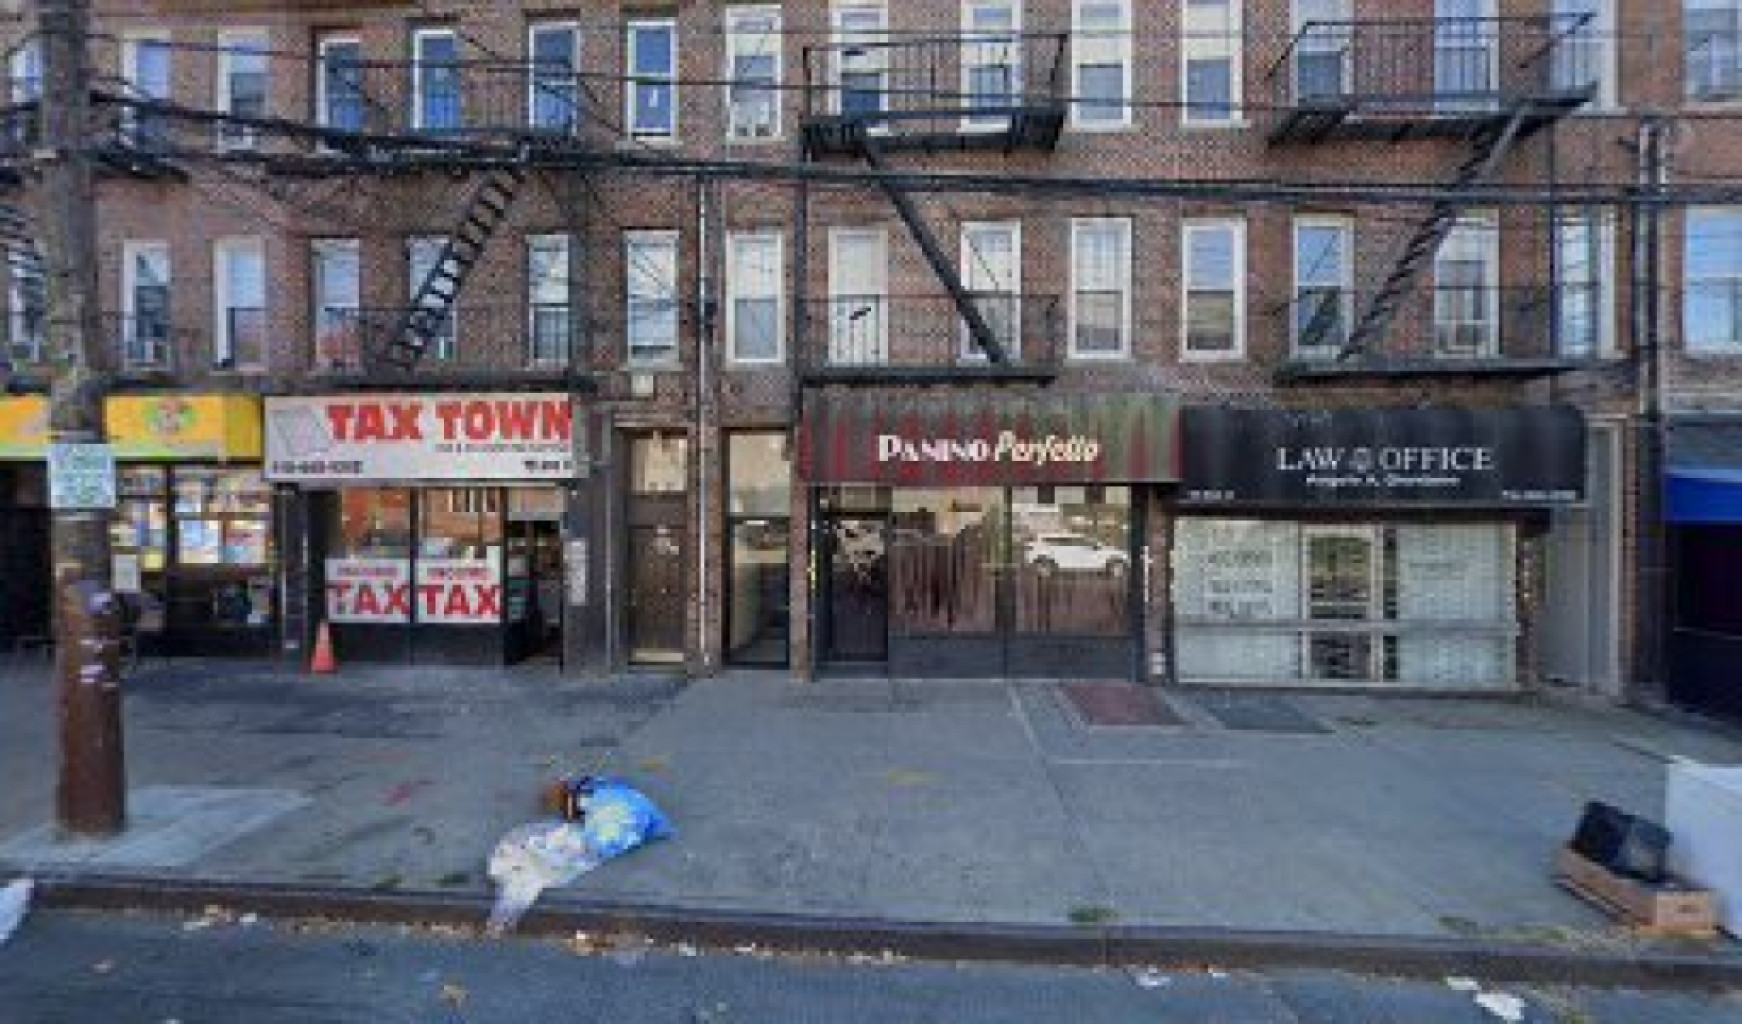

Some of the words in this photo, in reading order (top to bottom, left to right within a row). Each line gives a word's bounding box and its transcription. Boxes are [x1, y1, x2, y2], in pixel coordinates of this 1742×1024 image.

[327, 404, 422, 440] TAX
[435, 401, 573, 440] TOWN
[879, 434, 990, 462] PANINO
[1276, 447, 1346, 470] LAW
[1379, 447, 1495, 470] OFFICE
[327, 583, 410, 615] TAX
[418, 583, 503, 615] TAX
